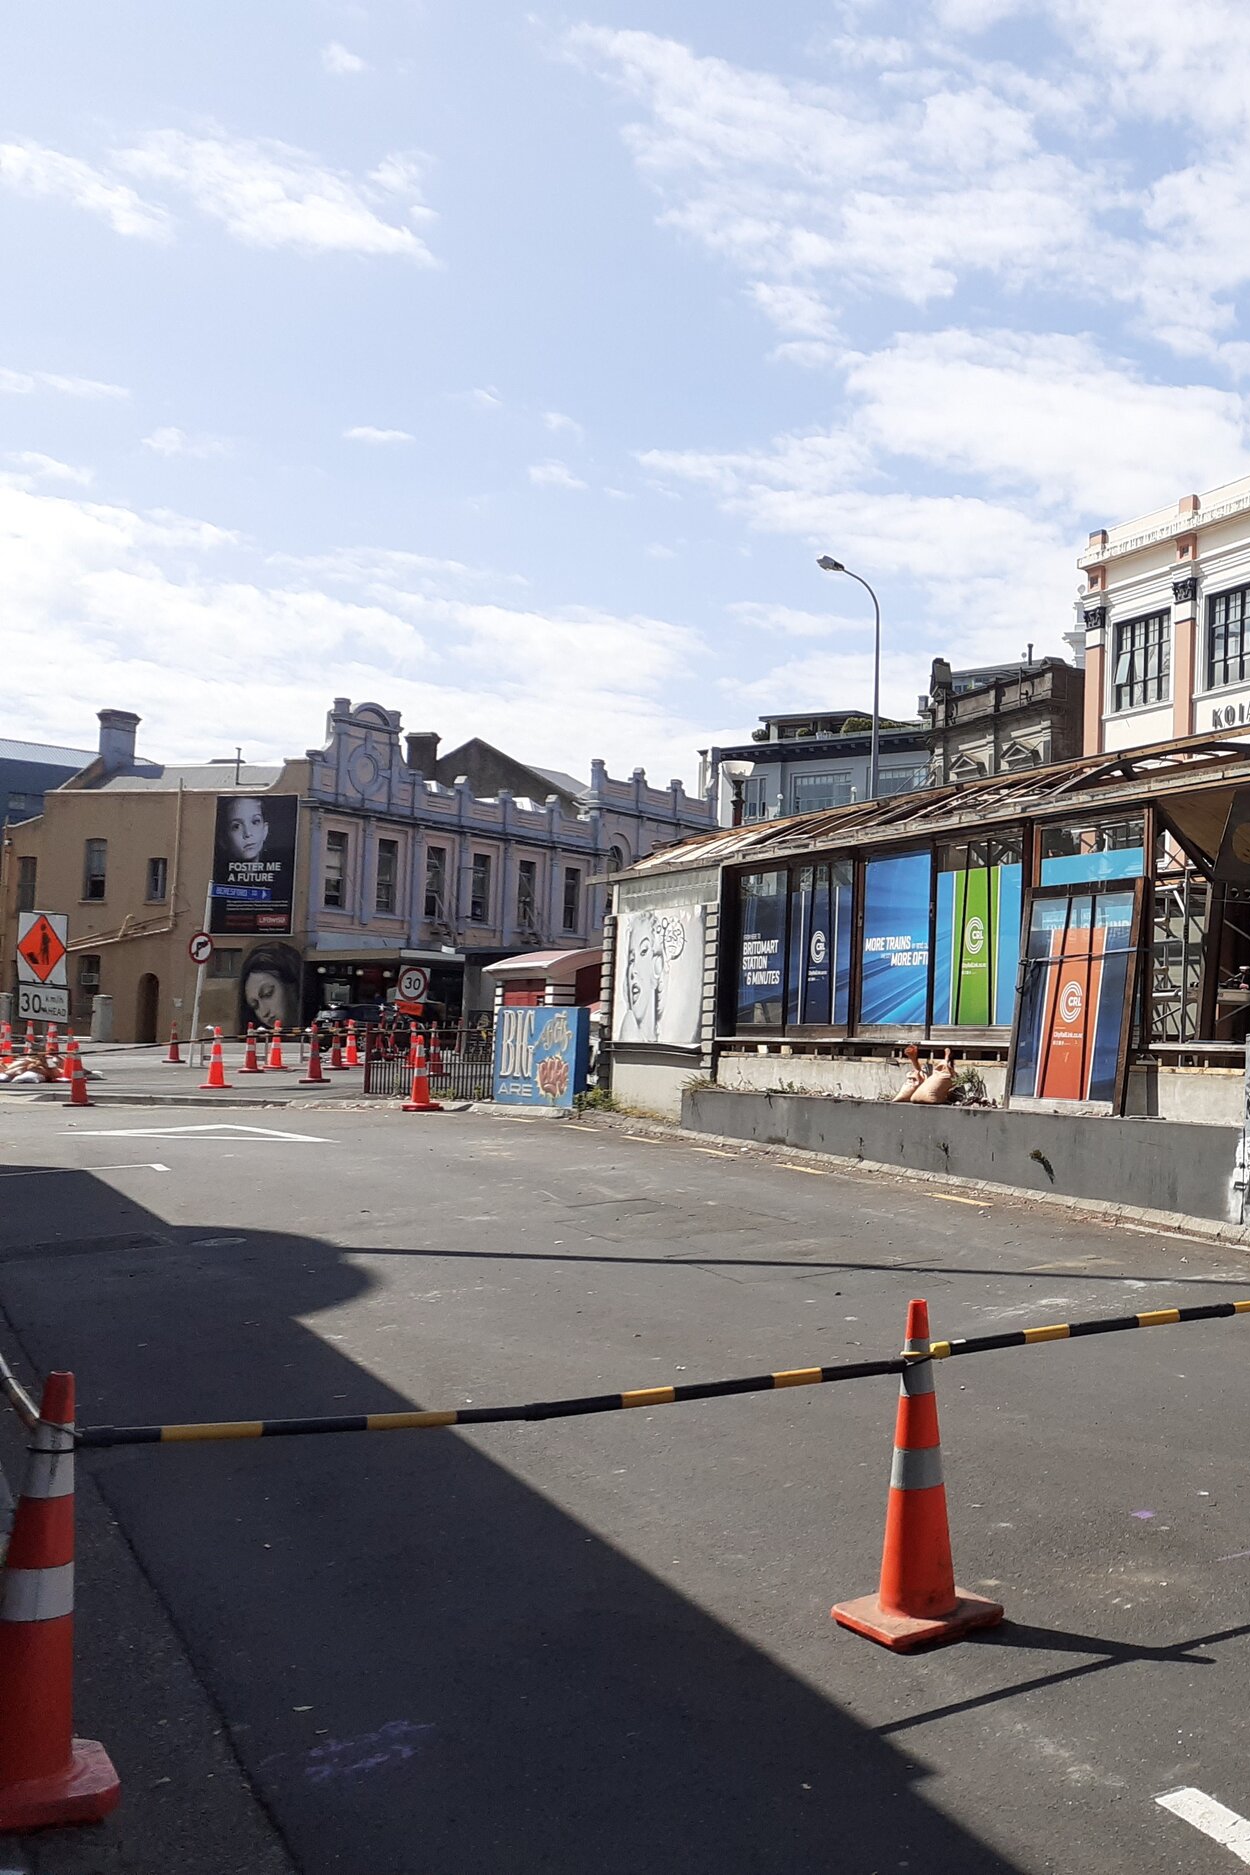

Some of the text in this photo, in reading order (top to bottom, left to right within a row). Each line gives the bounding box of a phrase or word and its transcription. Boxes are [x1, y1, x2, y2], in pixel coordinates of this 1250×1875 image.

[229, 862, 281, 872] FOSTER ME
[228, 873, 274, 882] A FUTURE
[742, 940, 779, 955] BRITOMART
[865, 938, 885, 951] MORE
[886, 936, 912, 950] TRAINS
[742, 956, 768, 970] STATION
[891, 952, 911, 966] MORE
[405, 977, 421, 990] 30
[746, 972, 752, 985] 6
[752, 970, 780, 985] MINUTES
[21, 993, 41, 1013] 30
[500, 1009, 535, 1078] BIG
[497, 1083, 533, 1096] ARE
